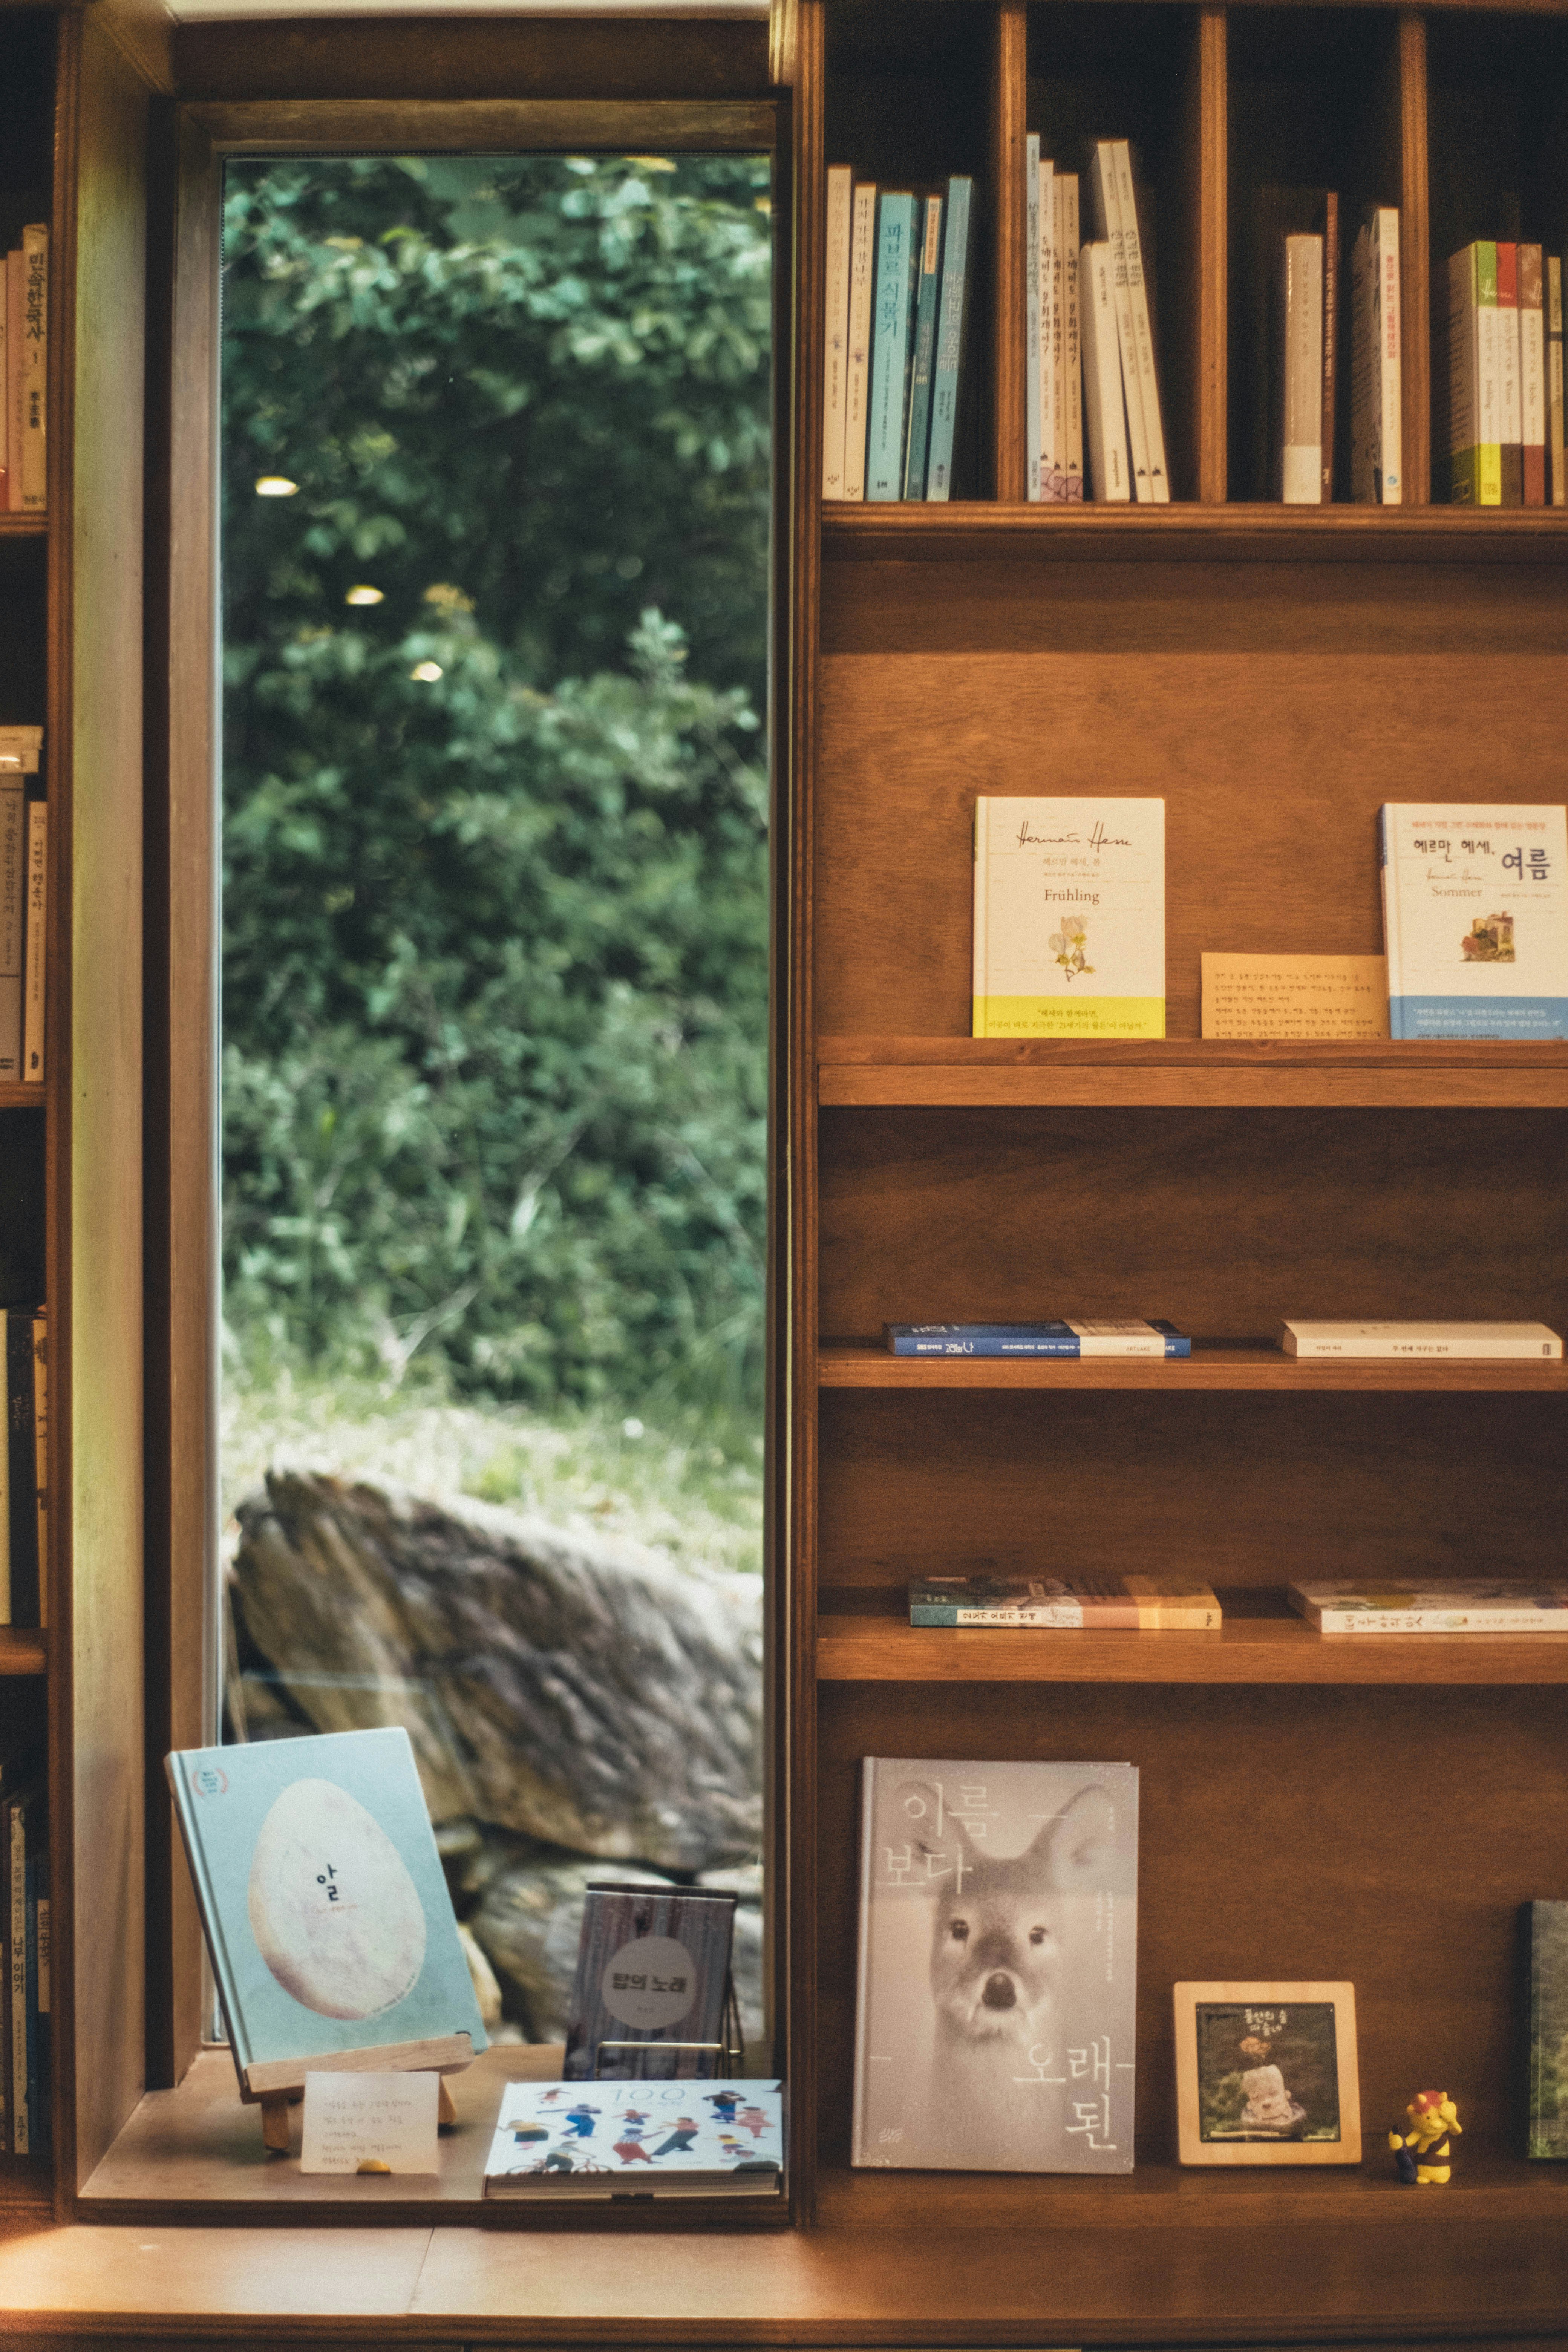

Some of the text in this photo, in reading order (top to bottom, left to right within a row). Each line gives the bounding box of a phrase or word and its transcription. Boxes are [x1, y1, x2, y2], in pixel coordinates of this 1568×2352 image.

[882, 223, 903, 276] 파브르
[879, 282, 899, 339] 식물기
[1041, 236, 1051, 354] 도깨비도 문화재야?
[1068, 248, 1078, 365] 도깨비도 문화재야?
[1413, 839, 1453, 864] 헤르만
[1501, 847, 1551, 881] 여름
[1044, 888, 1100, 906] Frühling
[1432, 886, 1483, 898] Sommer
[1013, 1021, 1028, 1030] 바로
[991, 1611, 1015, 1620] 오르기
[903, 1783, 1000, 1839] 이름
[316, 1863, 338, 1902] 알
[881, 1843, 974, 1895] 보다
[13, 1937, 24, 1958] 나무
[13, 1962, 24, 1994] 이야기
[651, 1976, 687, 1994] 노래
[1012, 2035, 1112, 2092] 오래
[610, 2088, 686, 2102] 100
[1066, 2093, 1118, 2151] 된
